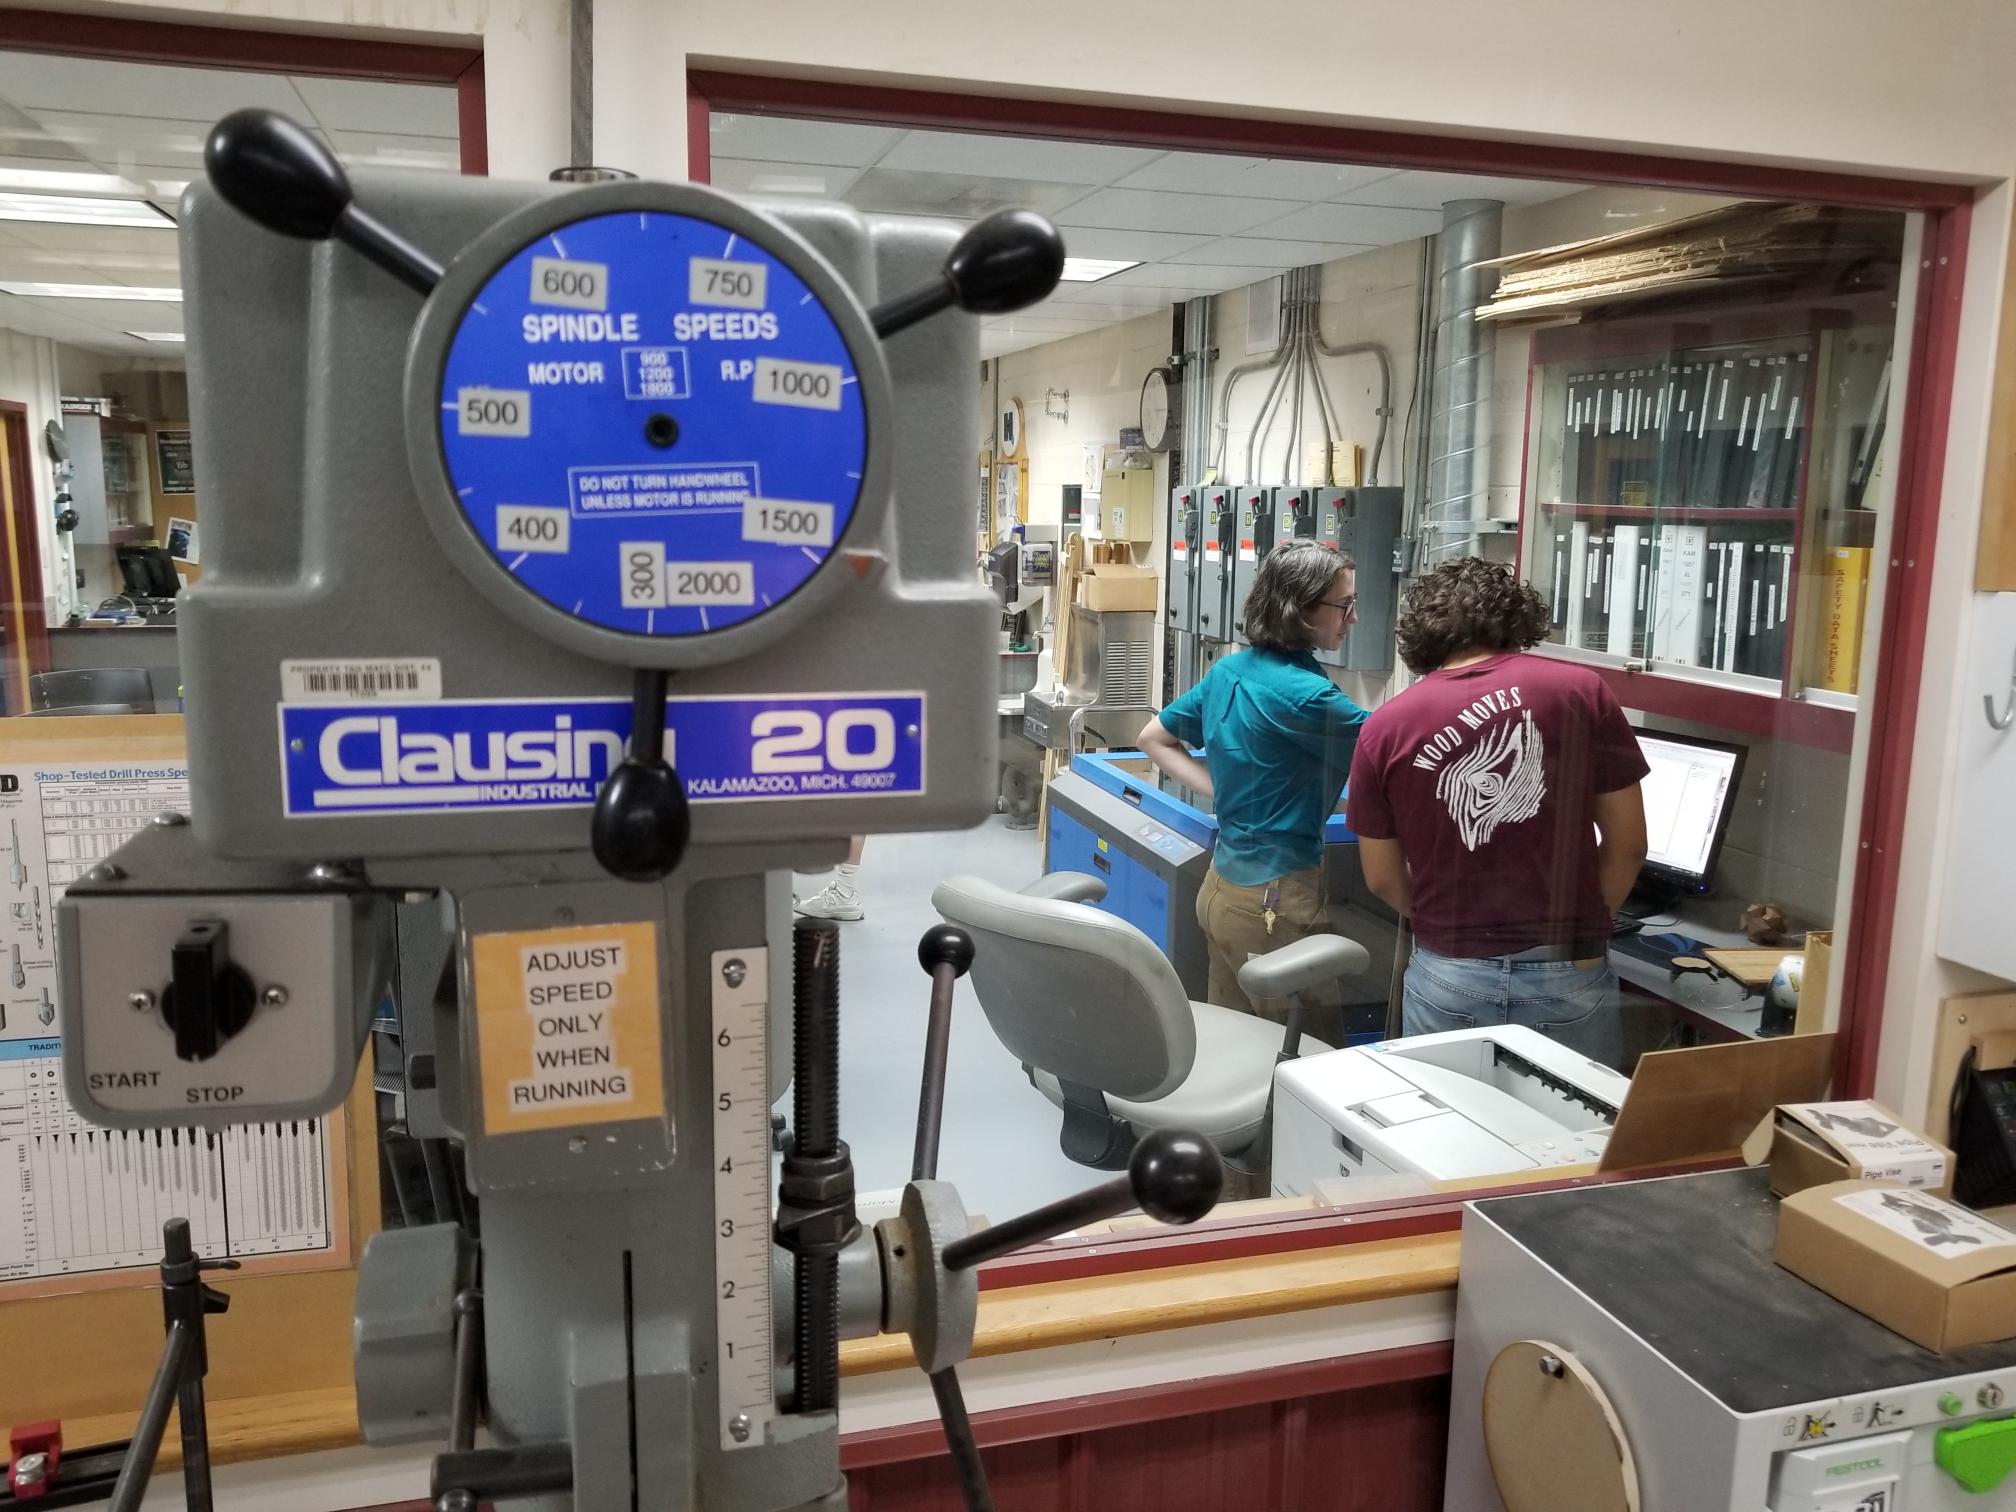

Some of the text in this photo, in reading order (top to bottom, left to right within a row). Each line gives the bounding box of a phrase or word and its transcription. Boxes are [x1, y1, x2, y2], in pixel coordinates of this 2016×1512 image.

[543, 269, 596, 298] 600
[704, 269, 753, 297] 750
[522, 312, 780, 344] SPINDLE SPEEDS
[528, 362, 605, 385] MOTOR
[768, 368, 831, 399] 1000
[466, 399, 519, 426] 500
[578, 471, 749, 493] DO NOT TURN HANDWHEEL
[580, 493, 632, 511] UNLESS
[633, 491, 679, 509] MOTOR
[680, 490, 694, 506] IS
[507, 516, 559, 542] 400
[757, 508, 820, 536] 1500
[631, 551, 656, 600] 300
[677, 571, 742, 596] 2000
[1827, 569, 1846, 683] SAFETY DATA SHEETS
[751, 708, 897, 775] 20
[1412, 686, 1522, 772] WOOD MOVES
[109, 769, 133, 780] Drill
[135, 768, 166, 779] Press
[687, 776, 799, 796] KALAMAZOO,
[801, 774, 849, 792] MICH.
[481, 782, 592, 801] INDUSTRIAL
[526, 946, 621, 973] ADJUST
[529, 981, 613, 1006] SPEED
[538, 1012, 604, 1037] ONLY
[718, 1028, 731, 1048] 6
[536, 1045, 610, 1070] WHEN
[89, 1071, 162, 1090] START
[513, 1075, 627, 1105] RUNNING
[186, 1086, 244, 1104] STOP
[718, 1093, 731, 1111] 5
[720, 1157, 732, 1175] 4
[1865, 1168, 1902, 1180] Pipe Vise
[720, 1220, 734, 1238] 3
[722, 1280, 735, 1299] 2
[725, 1342, 734, 1359] 1
